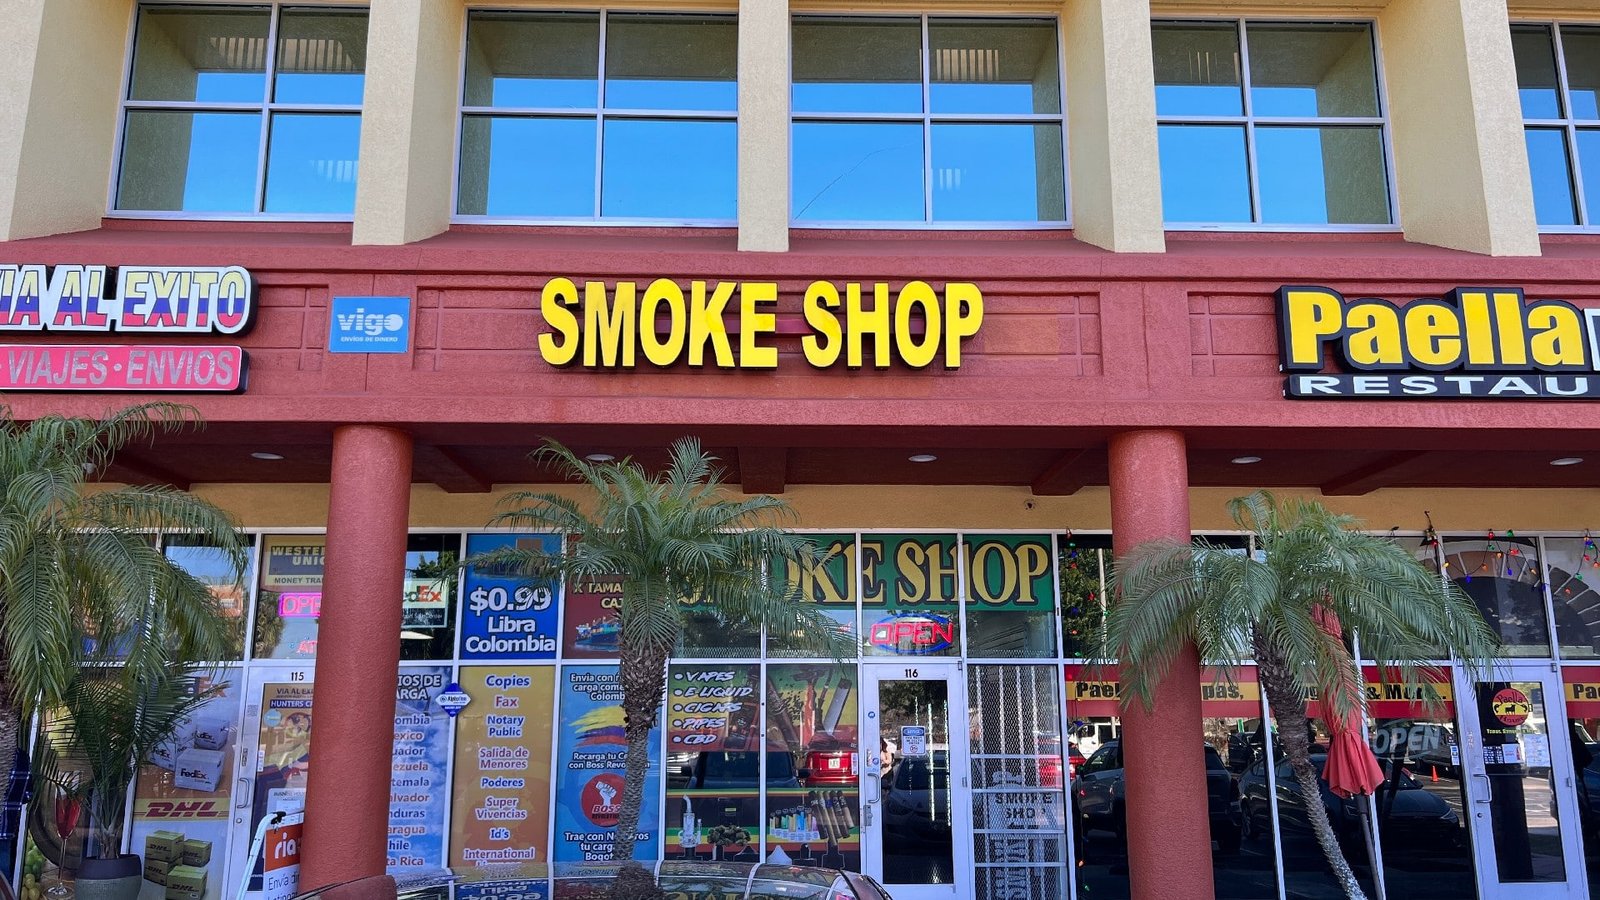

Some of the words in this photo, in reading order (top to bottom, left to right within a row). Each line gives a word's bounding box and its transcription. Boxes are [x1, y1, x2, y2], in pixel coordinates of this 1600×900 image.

[53, 270, 108, 326] AL
[122, 270, 246, 329] EXITO
[336, 307, 404, 336] vigo
[537, 277, 778, 369] SMOKE
[801, 280, 984, 369] SHOP
[1287, 291, 1585, 366] Paella
[8, 350, 109, 384] VIAJES
[126, 350, 233, 385] ENVIOS
[1300, 375, 1589, 396] RESTAU
[898, 541, 1049, 603] SHOP
[588, 582, 625, 593] TAMA
[469, 586, 552, 617] $0.99
[487, 615, 536, 633] Libra
[870, 621, 954, 644] OPEN
[465, 635, 556, 653] Colombia
[291, 671, 305, 681] 115
[570, 673, 595, 682] Envia
[686, 671, 735, 681] VAPES
[905, 668, 919, 678] 116
[423, 675, 441, 687] DE
[486, 675, 530, 689] Copies
[573, 684, 598, 692] carga
[1367, 686, 1381, 699] &
[1573, 683, 1600, 699] Pa
[271, 700, 304, 708] HUNTERS
[495, 696, 518, 707] Fax
[683, 702, 742, 713] CIGARS
[488, 715, 524, 727] Notary
[682, 718, 727, 729] PIPES
[489, 726, 521, 737] Public
[683, 734, 718, 745] CBD
[1372, 725, 1441, 754] OPEN
[480, 748, 512, 758] Salida
[514, 748, 528, 758] de
[573, 753, 606, 761] Recarga
[480, 759, 528, 769] Menores
[586, 761, 605, 769] Boss
[180, 768, 208, 780] FedEx
[481, 778, 524, 788] Poderes
[486, 797, 518, 809] Super
[145, 802, 219, 818] DHL
[477, 809, 526, 819] Vivencias
[592, 804, 621, 814] BOSS
[491, 829, 509, 838] Id's
[565, 832, 585, 841] Trae
[587, 833, 604, 841] con
[274, 832, 297, 859] ria
[581, 843, 591, 851] tu
[464, 848, 535, 859] International
[400, 857, 424, 866] Rica
